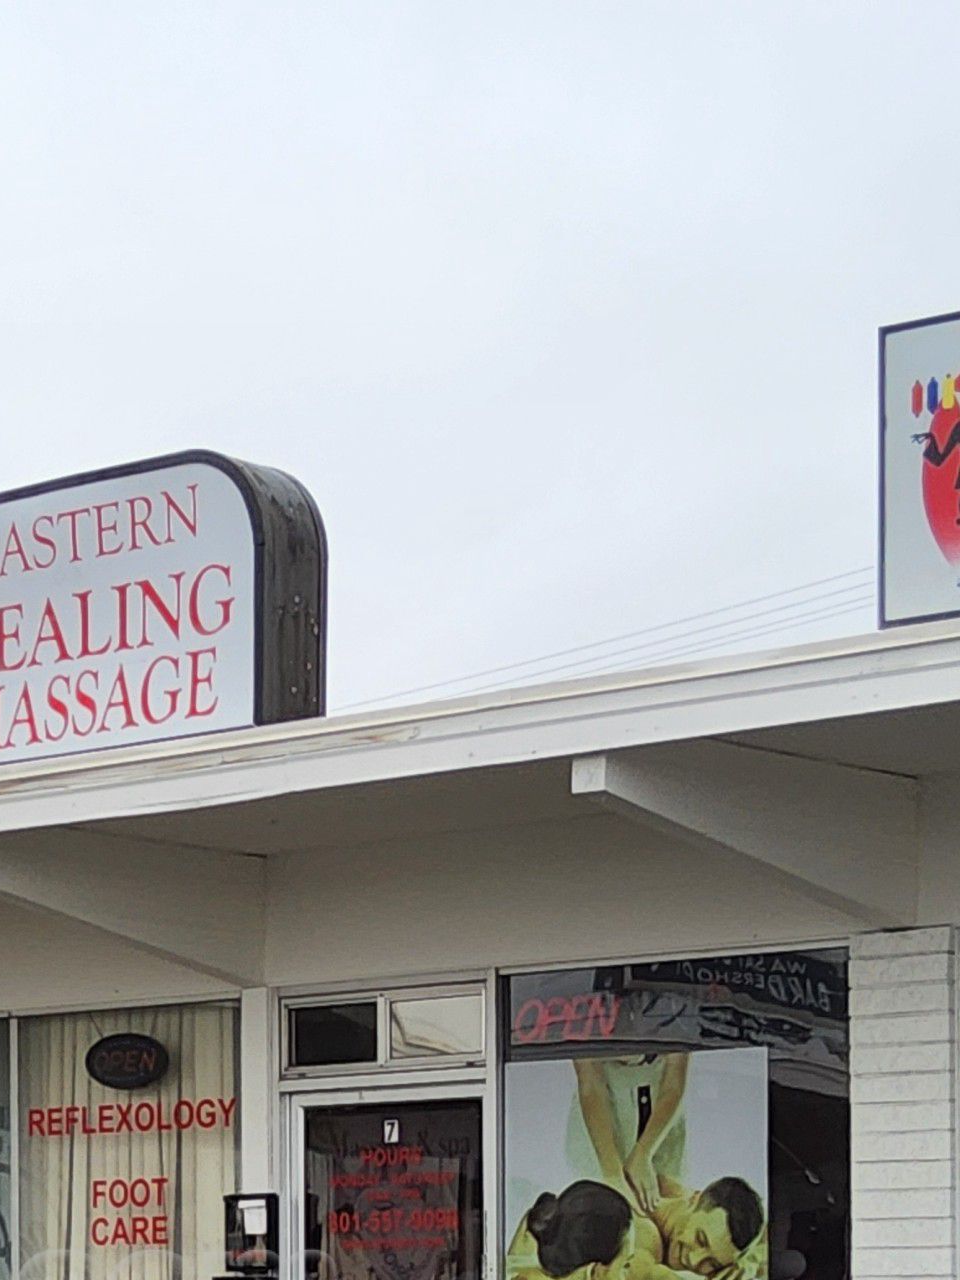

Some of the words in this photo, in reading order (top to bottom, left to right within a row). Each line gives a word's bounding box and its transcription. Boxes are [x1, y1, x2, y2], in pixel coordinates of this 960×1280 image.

[514, 993, 624, 1043] OPEN
[95, 1046, 157, 1072] OPEN
[28, 1097, 237, 1137] REFLEXOLOGY
[386, 1122, 396, 1142] 7
[92, 1178, 169, 1209] FOOT
[91, 1217, 169, 1246] CARE
